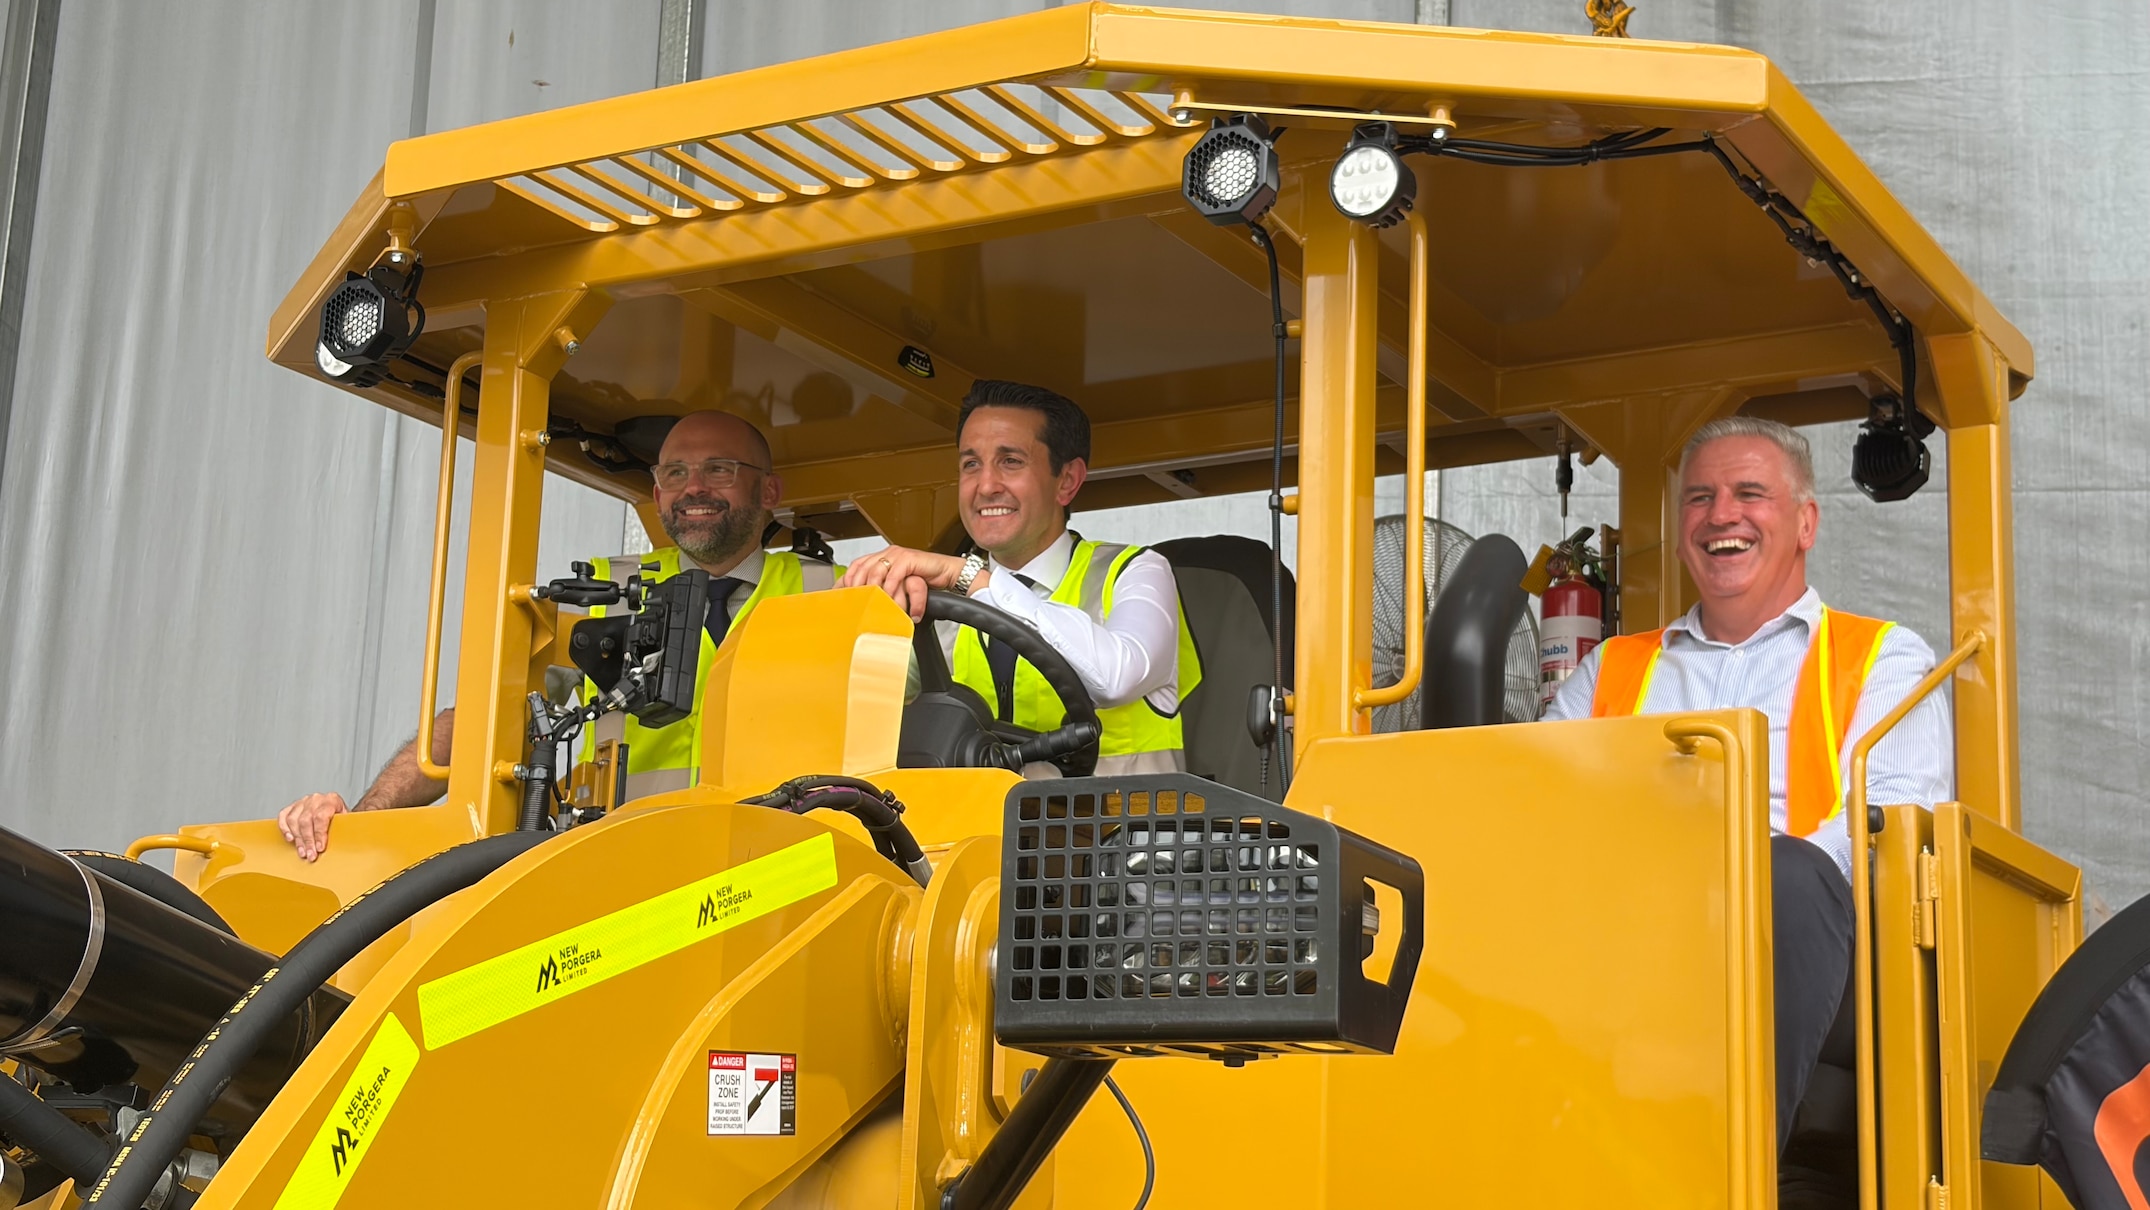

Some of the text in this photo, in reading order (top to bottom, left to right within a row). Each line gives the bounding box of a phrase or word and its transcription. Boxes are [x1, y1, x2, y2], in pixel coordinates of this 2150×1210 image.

[716, 883, 732, 899] NEW
[717, 889, 753, 911] PORGERA
[719, 906, 741, 920] LIMITED
[559, 943, 579, 960] NEW
[561, 948, 602, 974] PORGERA
[562, 967, 588, 983] LIMITED
[717, 1056, 744, 1067] DANGER
[714, 1074, 741, 1086] CRUSH
[351, 1066, 391, 1129] PORGERA
[718, 1087, 739, 1098] ZONE
[344, 1085, 365, 1120] NEW
[358, 1098, 382, 1136] LIMITED
